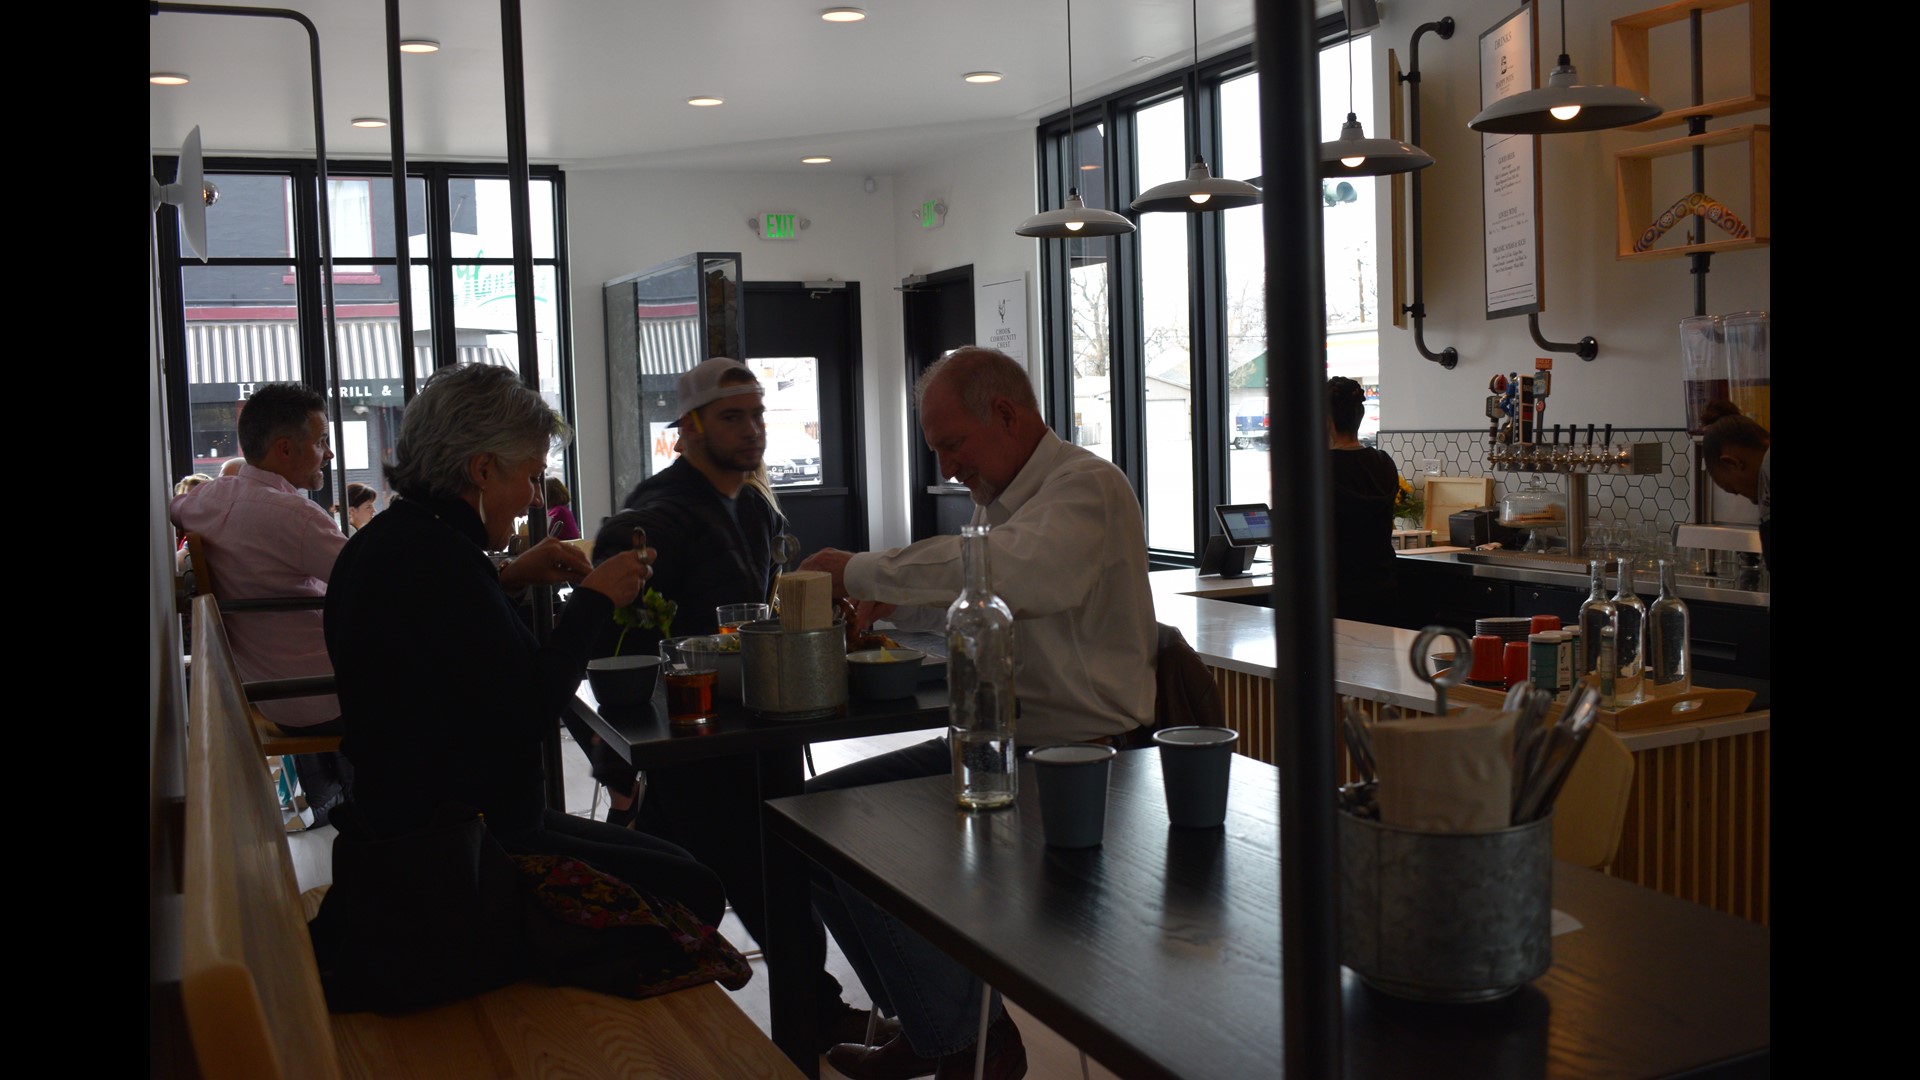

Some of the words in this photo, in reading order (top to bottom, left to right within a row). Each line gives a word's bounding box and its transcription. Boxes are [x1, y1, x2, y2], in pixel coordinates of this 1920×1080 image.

[1494, 31, 1512, 50] DRINKS
[766, 214, 795, 238] EXIT
[995, 327, 1011, 336] CHOOK
[990, 333, 1017, 343] COMMUNITY
[996, 341, 1011, 349] CHEST
[381, 384, 392, 397] &
